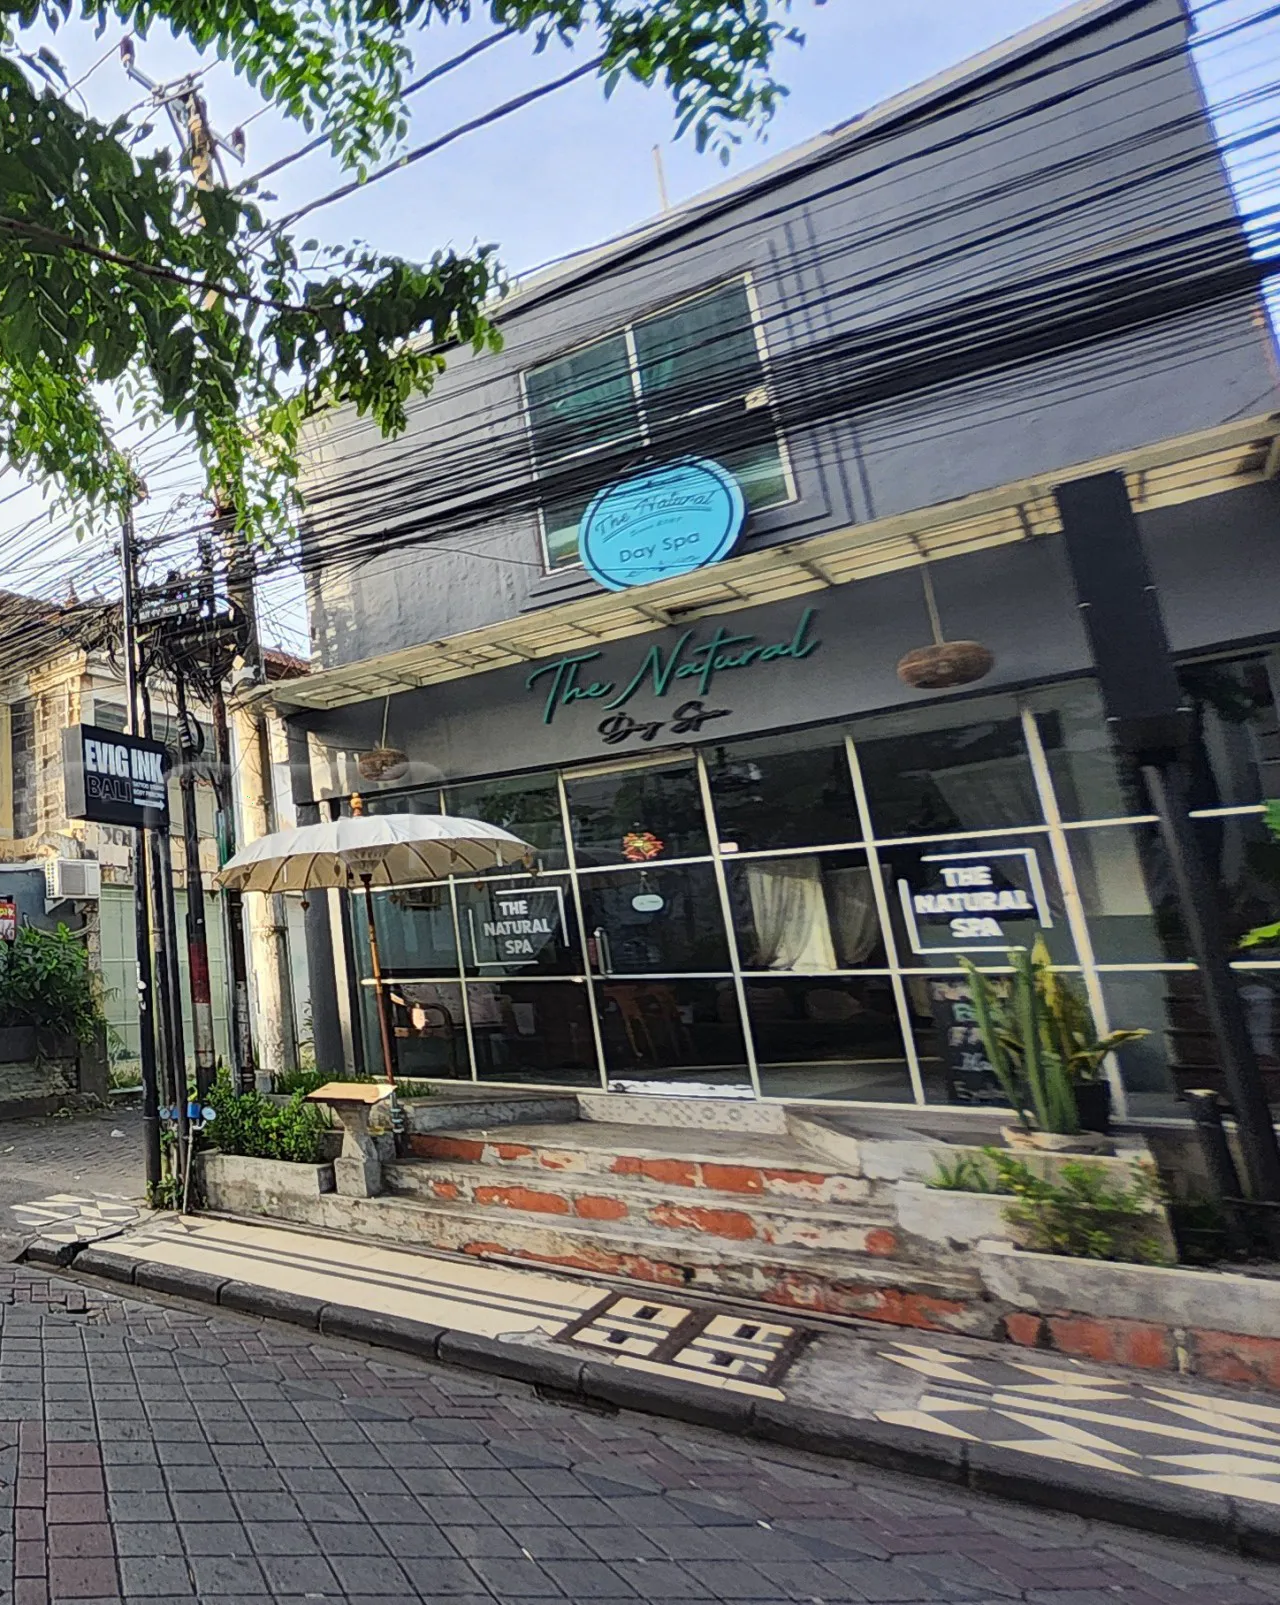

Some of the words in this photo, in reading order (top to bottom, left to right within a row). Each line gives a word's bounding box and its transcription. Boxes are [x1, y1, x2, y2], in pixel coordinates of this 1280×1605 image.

[594, 511, 631, 537] The
[632, 490, 716, 515] Natural
[619, 543, 657, 563] Day
[661, 531, 701, 552] Spa
[525, 651, 614, 725] The
[602, 607, 821, 712] Natural
[84, 738, 130, 779] EVIG
[130, 748, 165, 785] INK
[87, 774, 133, 803] BALI
[939, 865, 994, 888] THE
[498, 899, 529, 917] THE
[914, 889, 1034, 914] NATURAL
[482, 918, 553, 937] NATURAL
[949, 916, 1005, 938] SPA
[504, 938, 534, 955] SPA
